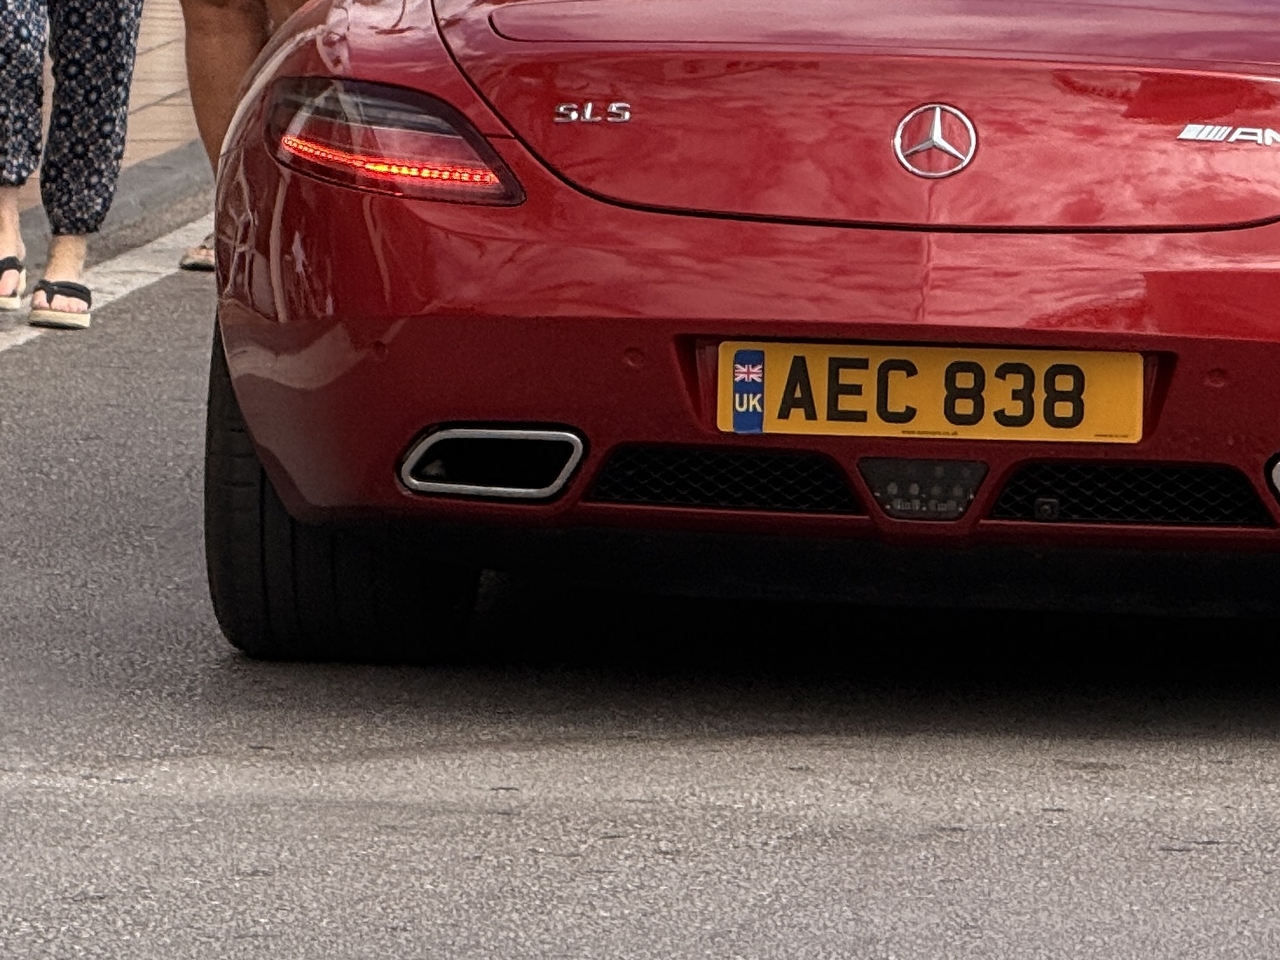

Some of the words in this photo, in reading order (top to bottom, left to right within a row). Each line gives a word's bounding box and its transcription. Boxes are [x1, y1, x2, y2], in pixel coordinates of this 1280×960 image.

[553, 101, 631, 123] SLS
[734, 393, 763, 413] UK
[777, 354, 919, 424] AEC
[943, 360, 1086, 430] 838
